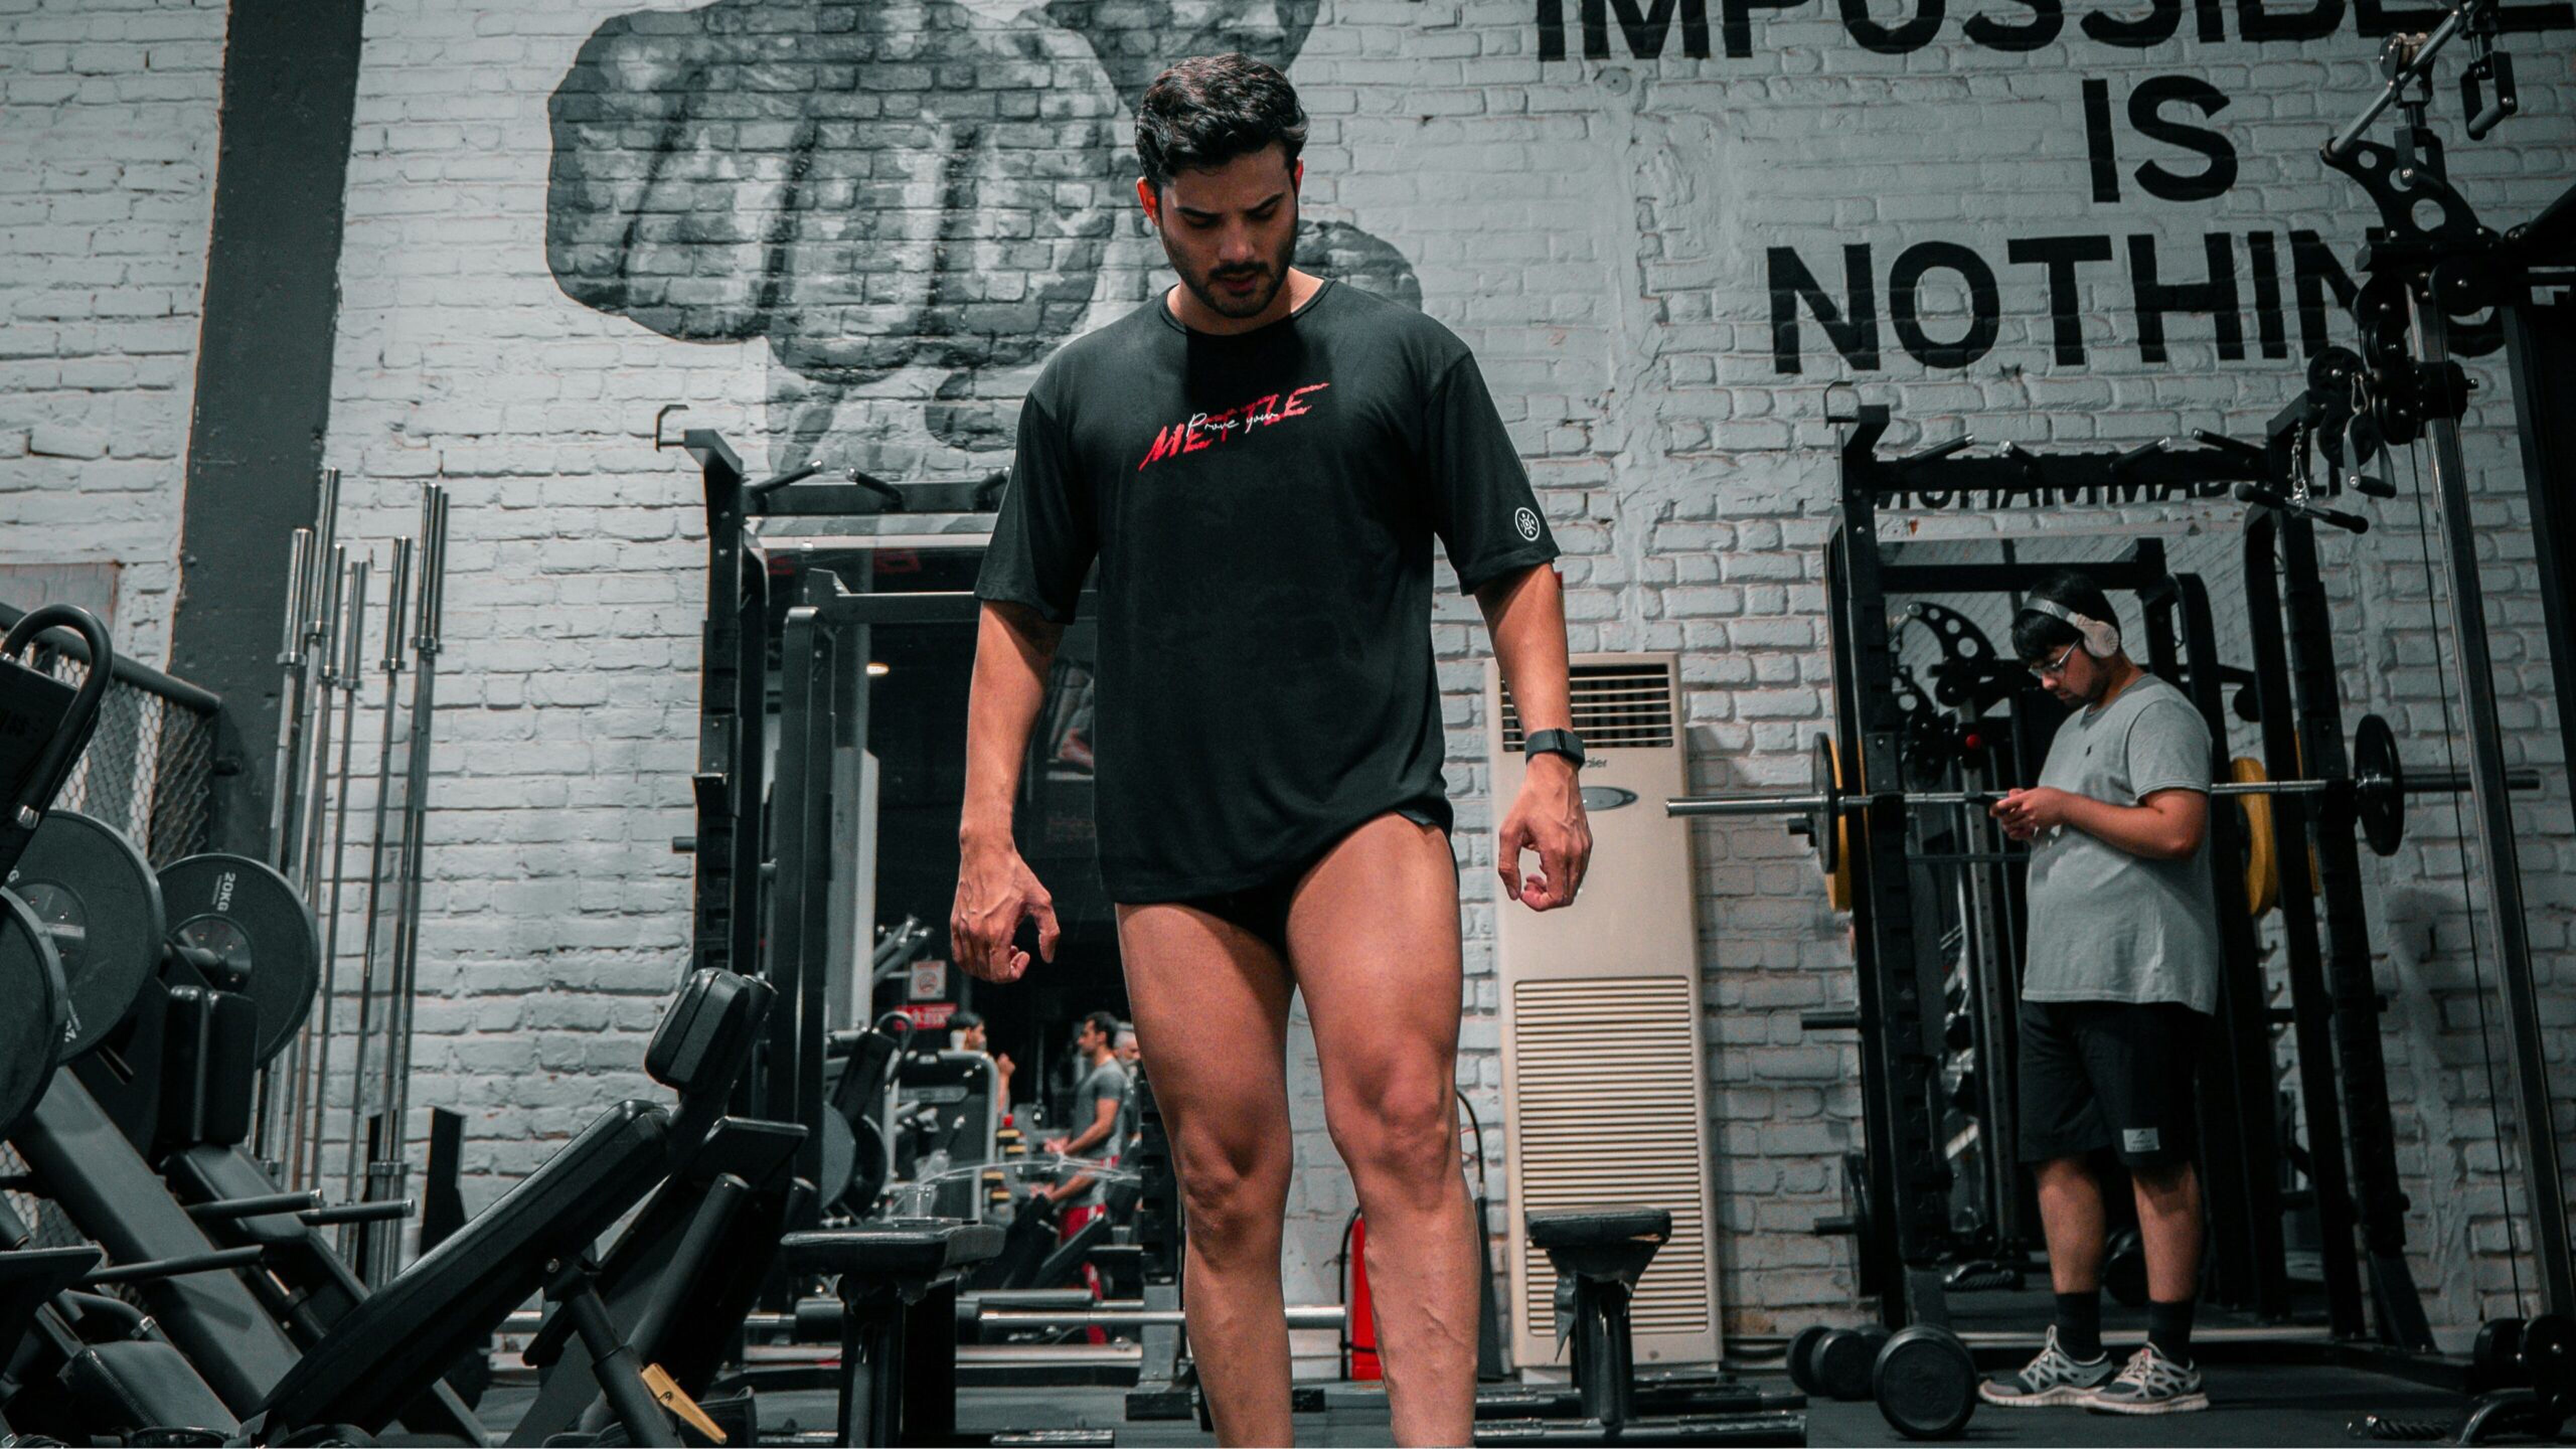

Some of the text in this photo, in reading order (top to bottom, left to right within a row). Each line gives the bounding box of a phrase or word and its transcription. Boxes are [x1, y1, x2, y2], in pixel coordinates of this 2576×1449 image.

[2082, 74, 2239, 203] IS
[1767, 227, 2506, 374] NOTHIN
[1186, 412, 1240, 437] Prove
[217, 872, 236, 912] 20KG
